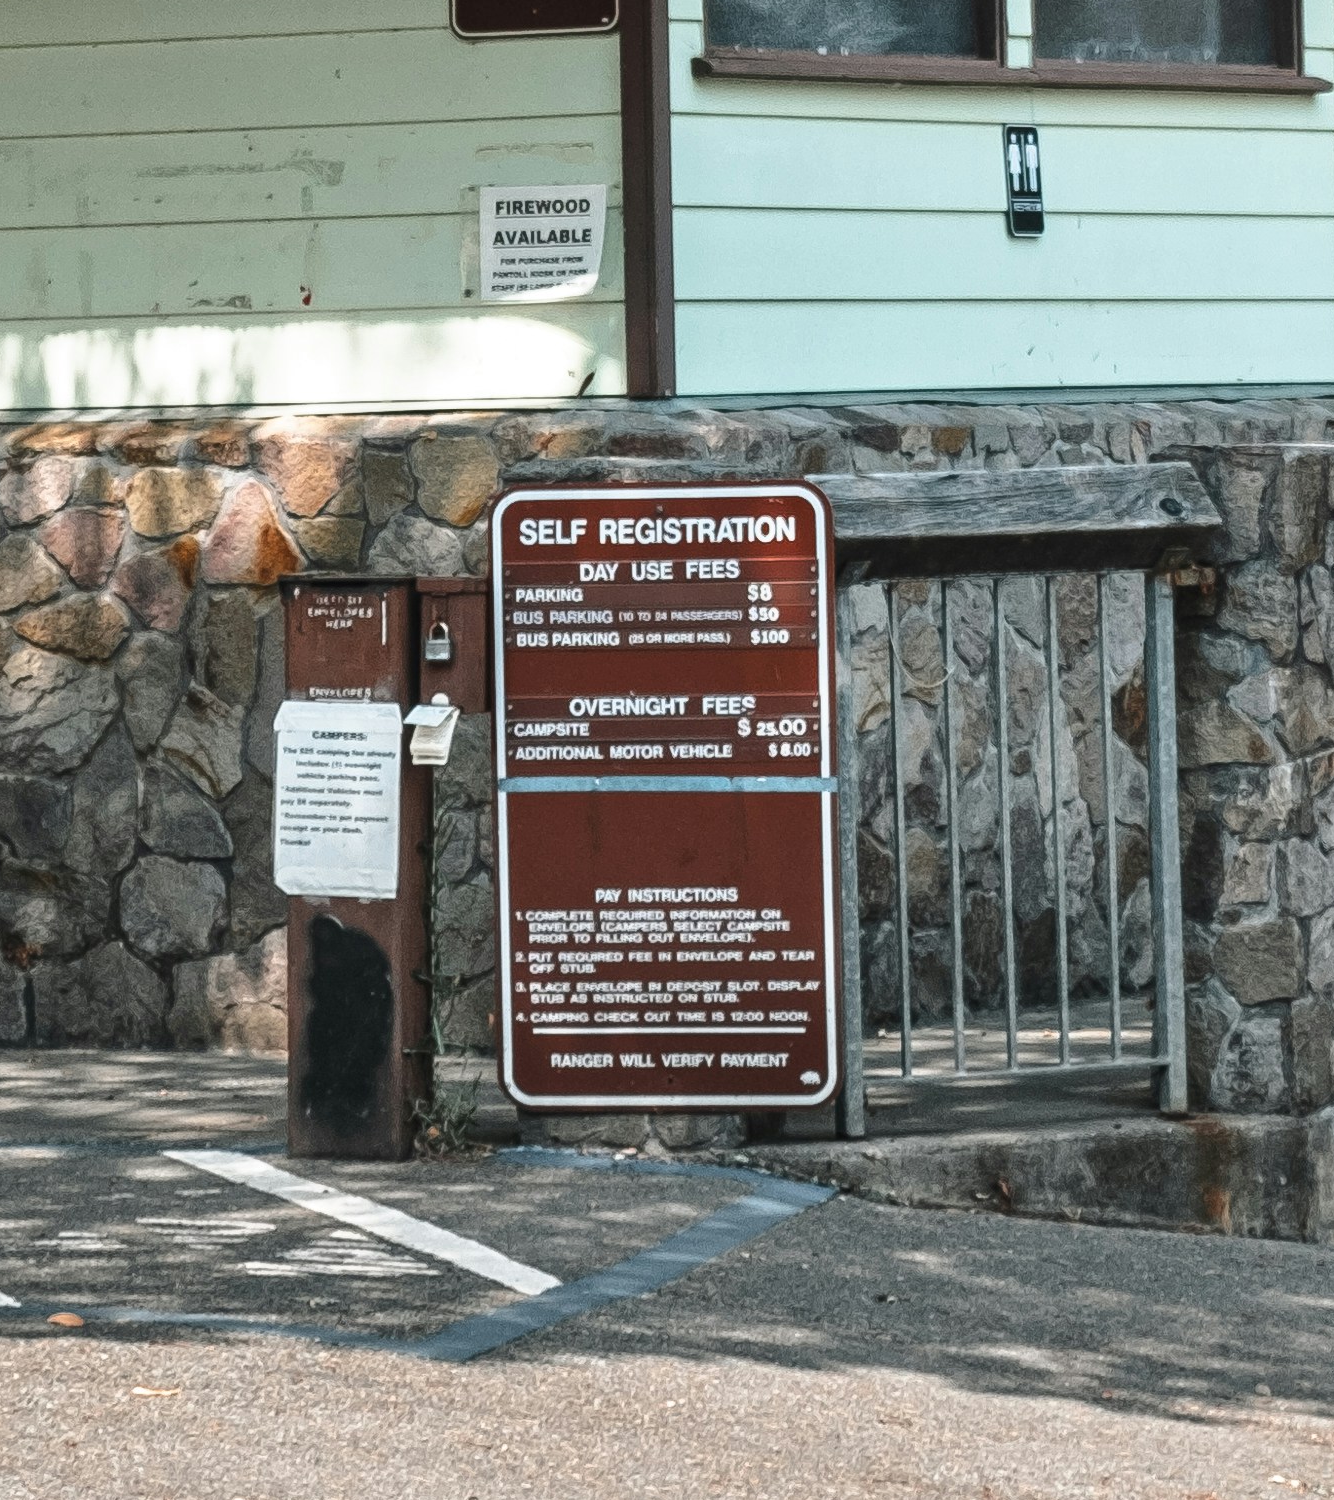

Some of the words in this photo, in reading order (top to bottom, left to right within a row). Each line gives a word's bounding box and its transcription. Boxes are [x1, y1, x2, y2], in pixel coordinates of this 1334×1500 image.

[495, 199, 590, 215] FIREWOOD
[493, 228, 592, 245] AVAILABLE
[519, 518, 588, 545] SELF
[599, 516, 797, 544] REGISTRATION
[578, 562, 618, 582] DAY
[631, 561, 673, 580] USE
[685, 559, 741, 579] FEES
[515, 588, 583, 602] PARKING
[747, 583, 773, 602] $8
[307, 607, 373, 618] ENVELOPES
[513, 611, 544, 625] BUS
[549, 610, 613, 624] PARKING
[618, 611, 634, 622] (10
[637, 611, 651, 622] TO
[670, 610, 743, 622] PASSENGERS)
[748, 607, 779, 622] $50
[516, 633, 549, 647] BUS
[552, 631, 620, 646] PARKING
[628, 633, 644, 645] (25
[646, 633, 662, 643] OR
[664, 633, 695, 644] MORE
[750, 629, 789, 645] $100
[309, 687, 371, 698] ENVELOPES
[569, 696, 689, 717] OVERNIGHT
[702, 696, 756, 715] FEES
[514, 722, 590, 737] CAMPSITE
[516, 745, 603, 760] ADDITIONAL
[609, 745, 663, 759] MOTOR
[669, 744, 733, 758] VEHICLE
[595, 889, 622, 903] PAY
[627, 887, 739, 902] INSTRUCTIONS
[525, 911, 594, 922] COMPLETE
[599, 910, 665, 921] REQUIRED
[670, 909, 756, 921] INFORMATION
[761, 909, 782, 920] ON
[528, 922, 595, 932] ENVELOPE
[673, 921, 722, 932] SELECT
[727, 920, 790, 931] CAMPSITE
[528, 933, 568, 944] PRIOR
[574, 933, 590, 943] TO
[595, 933, 643, 943] FILLING
[648, 933, 675, 943] OUT
[528, 953, 552, 963] PUT
[558, 952, 623, 962] REQUIRED
[628, 952, 653, 962] FEE
[658, 952, 671, 962] IN
[677, 951, 742, 962] ENVELOPE
[748, 951, 776, 961] AND
[781, 950, 815, 961] TEAR
[529, 964, 555, 974] OFF
[529, 982, 571, 992] PLACE
[576, 982, 643, 992] ENVELOPE
[648, 982, 661, 992] IN
[667, 982, 722, 992] DEPOSIT
[768, 981, 820, 991] DISPLAY
[531, 994, 565, 1004] STUB
[570, 994, 588, 1004] AS
[593, 993, 673, 1003] INSTRUCTED
[678, 993, 698, 1003] ON
[530, 1012, 589, 1023] CAMPING
[594, 1012, 639, 1022] CHECK
[644, 1012, 671, 1022] OUT
[677, 1012, 706, 1022] TIME
[711, 1012, 725, 1022] IS
[551, 1054, 613, 1067] RANGER
[619, 1054, 655, 1067] WILL
[661, 1053, 715, 1067] VERIFY
[721, 1052, 789, 1067] PAYMENT
